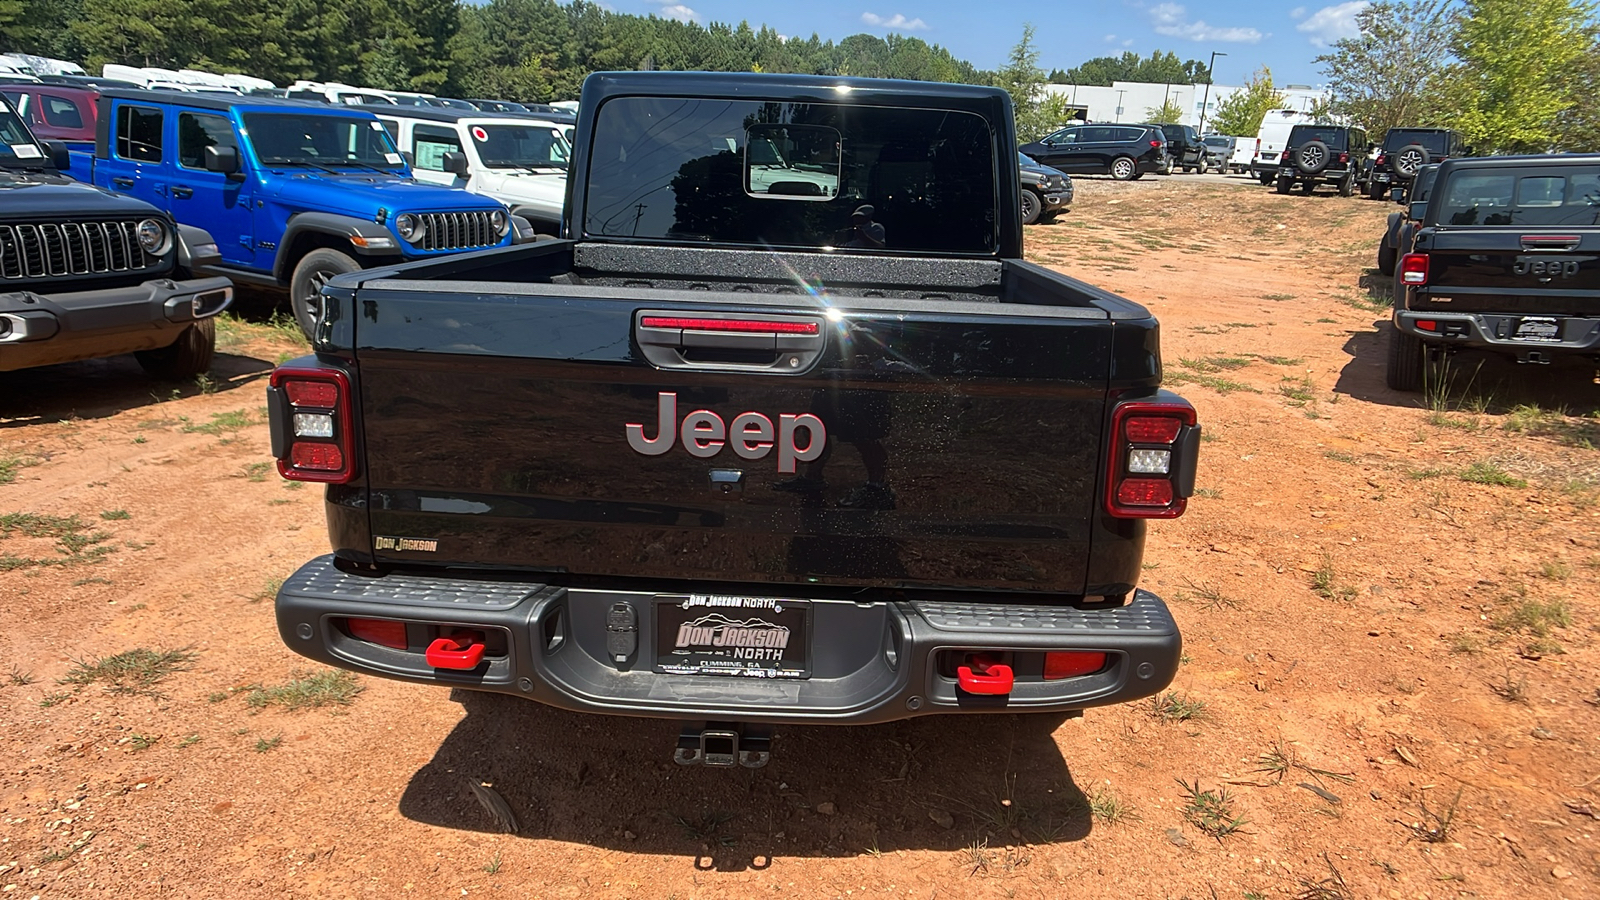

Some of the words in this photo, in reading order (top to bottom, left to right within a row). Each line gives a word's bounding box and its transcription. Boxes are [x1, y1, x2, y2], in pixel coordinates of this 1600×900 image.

[1513, 256, 1579, 279] Jeep
[625, 391, 827, 474] Jeep
[375, 536, 395, 550] DON
[395, 538, 437, 552] JACKSON
[743, 599, 776, 608] NORTH
[675, 626, 714, 647] DON
[714, 628, 790, 649] JACKSON
[734, 647, 784, 661] NORTH
[743, 669, 766, 678] Jeep
